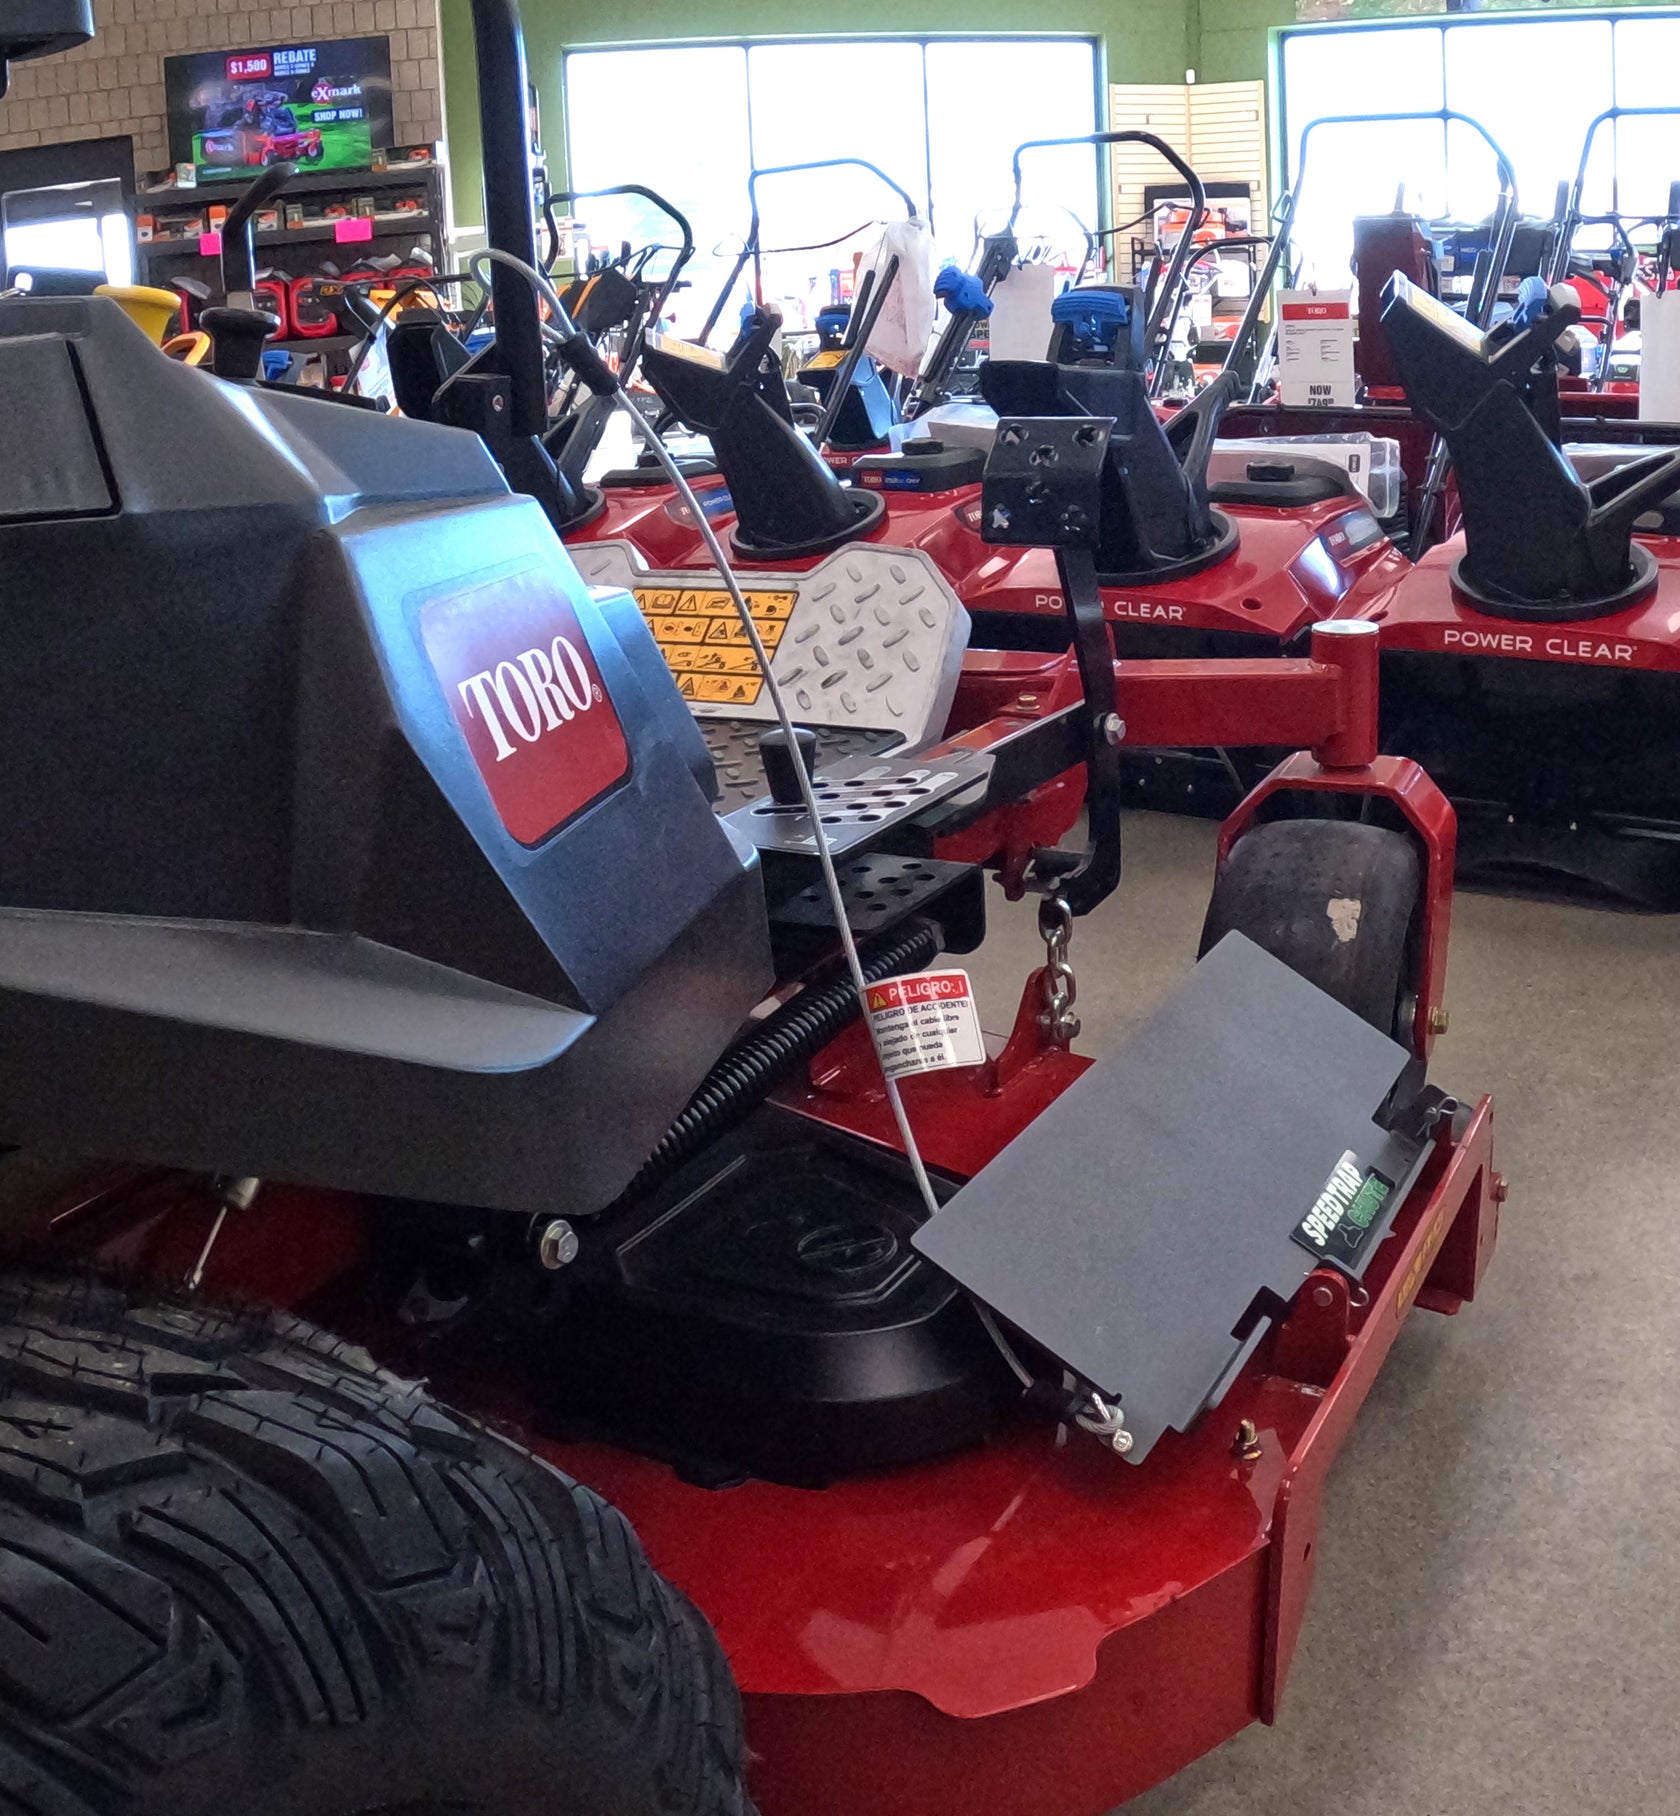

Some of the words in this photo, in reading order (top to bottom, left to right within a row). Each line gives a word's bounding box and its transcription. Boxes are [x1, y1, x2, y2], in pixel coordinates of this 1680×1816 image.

[230, 58, 267, 75] $1,500
[273, 49, 317, 64] REBATE
[314, 109, 337, 122] SHOP
[338, 107, 363, 120] NOW!
[1310, 385, 1331, 395] NOW
[967, 510, 982, 522] TOR
[1113, 601, 1184, 621] CLEAR
[1443, 629, 1533, 652] POWER
[1545, 638, 1633, 661] CLEAR
[921, 1000, 967, 1012] ACCDENTE
[1301, 1161, 1364, 1247] SPEEDTRAP
